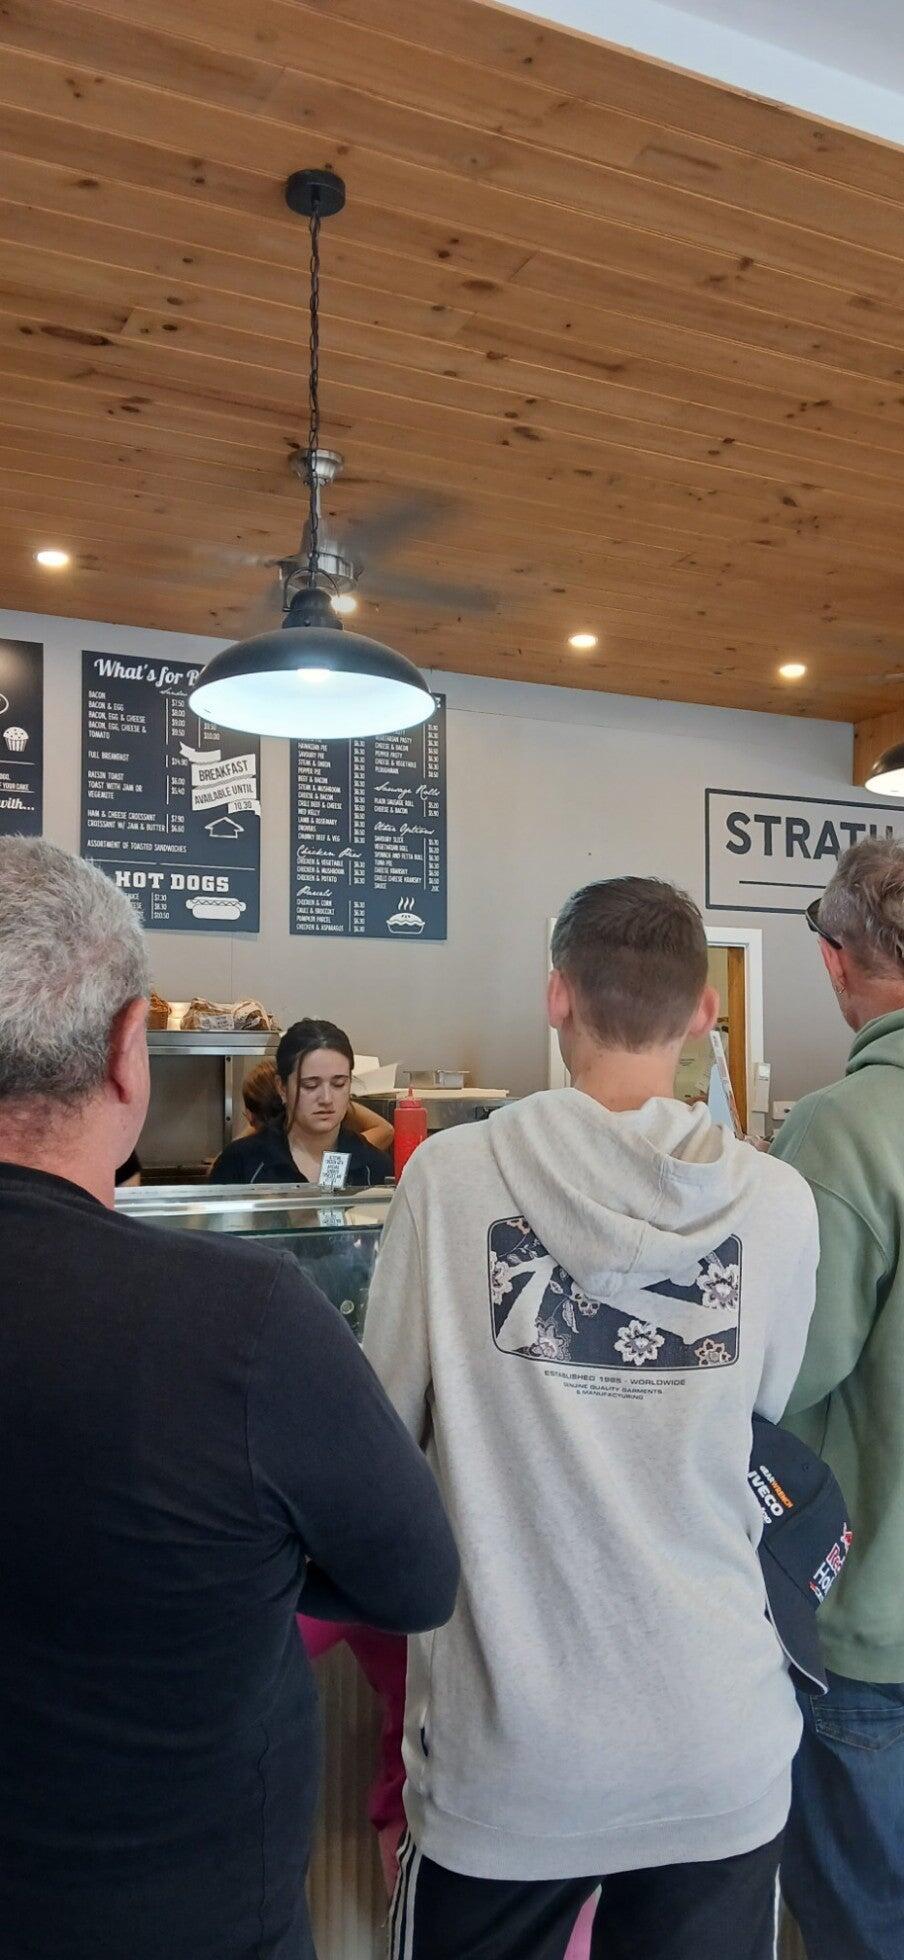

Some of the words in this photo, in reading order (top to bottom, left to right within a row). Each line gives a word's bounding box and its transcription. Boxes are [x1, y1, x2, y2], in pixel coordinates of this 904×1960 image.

[94, 659, 157, 681] What's
[155, 666, 183, 687] for
[89, 690, 105, 699] BACON
[89, 701, 105, 709] BACON
[114, 703, 124, 711] EGG
[108, 712, 119, 721] EGG
[127, 715, 145, 724] CHEESE
[121, 723, 140, 733] CHEESE
[89, 730, 110, 739] TOMATO
[88, 750, 100, 759] FULL
[108, 772, 124, 780] TOAST
[199, 760, 248, 781] BREAKFAST
[88, 781, 104, 789] TOAST
[374, 781, 412, 799] Sausage
[415, 785, 440, 800] Rolls
[195, 787, 231, 804] AVAILABLE
[232, 784, 253, 795] UNTIL
[87, 809, 100, 817] HAM
[108, 811, 127, 819] CHEESE
[374, 821, 396, 832] Other
[400, 823, 435, 836] Options
[297, 845, 335, 858] Chicken
[115, 871, 164, 889] HOT
[170, 874, 229, 892] DOGS
[545, 1370, 596, 1381] ESTABLISHED
[582, 1391, 644, 1400] MANUFACTURING
[747, 1471, 784, 1516] IVECO
